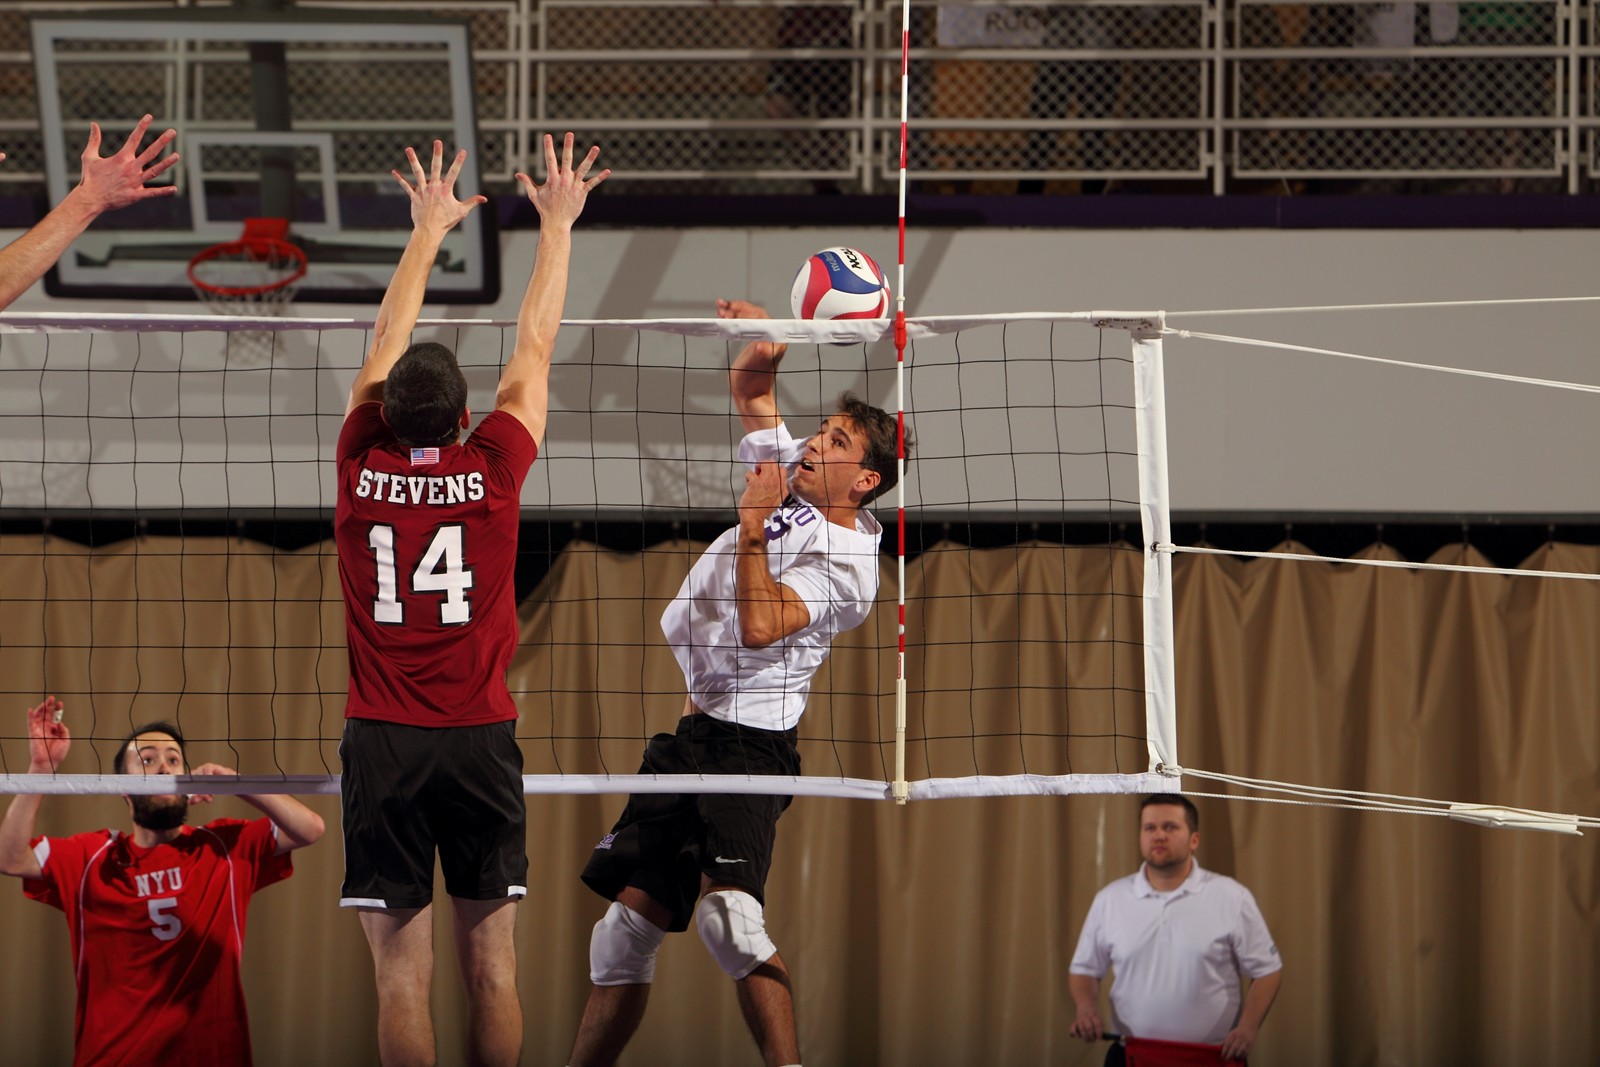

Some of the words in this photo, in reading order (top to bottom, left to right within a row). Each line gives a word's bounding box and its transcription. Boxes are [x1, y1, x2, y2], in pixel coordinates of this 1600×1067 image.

[840, 247, 862, 270] NCA
[355, 468, 485, 505] STEVENS
[369, 524, 473, 624] 14
[134, 866, 183, 898] NYU
[147, 896, 182, 941] 5
